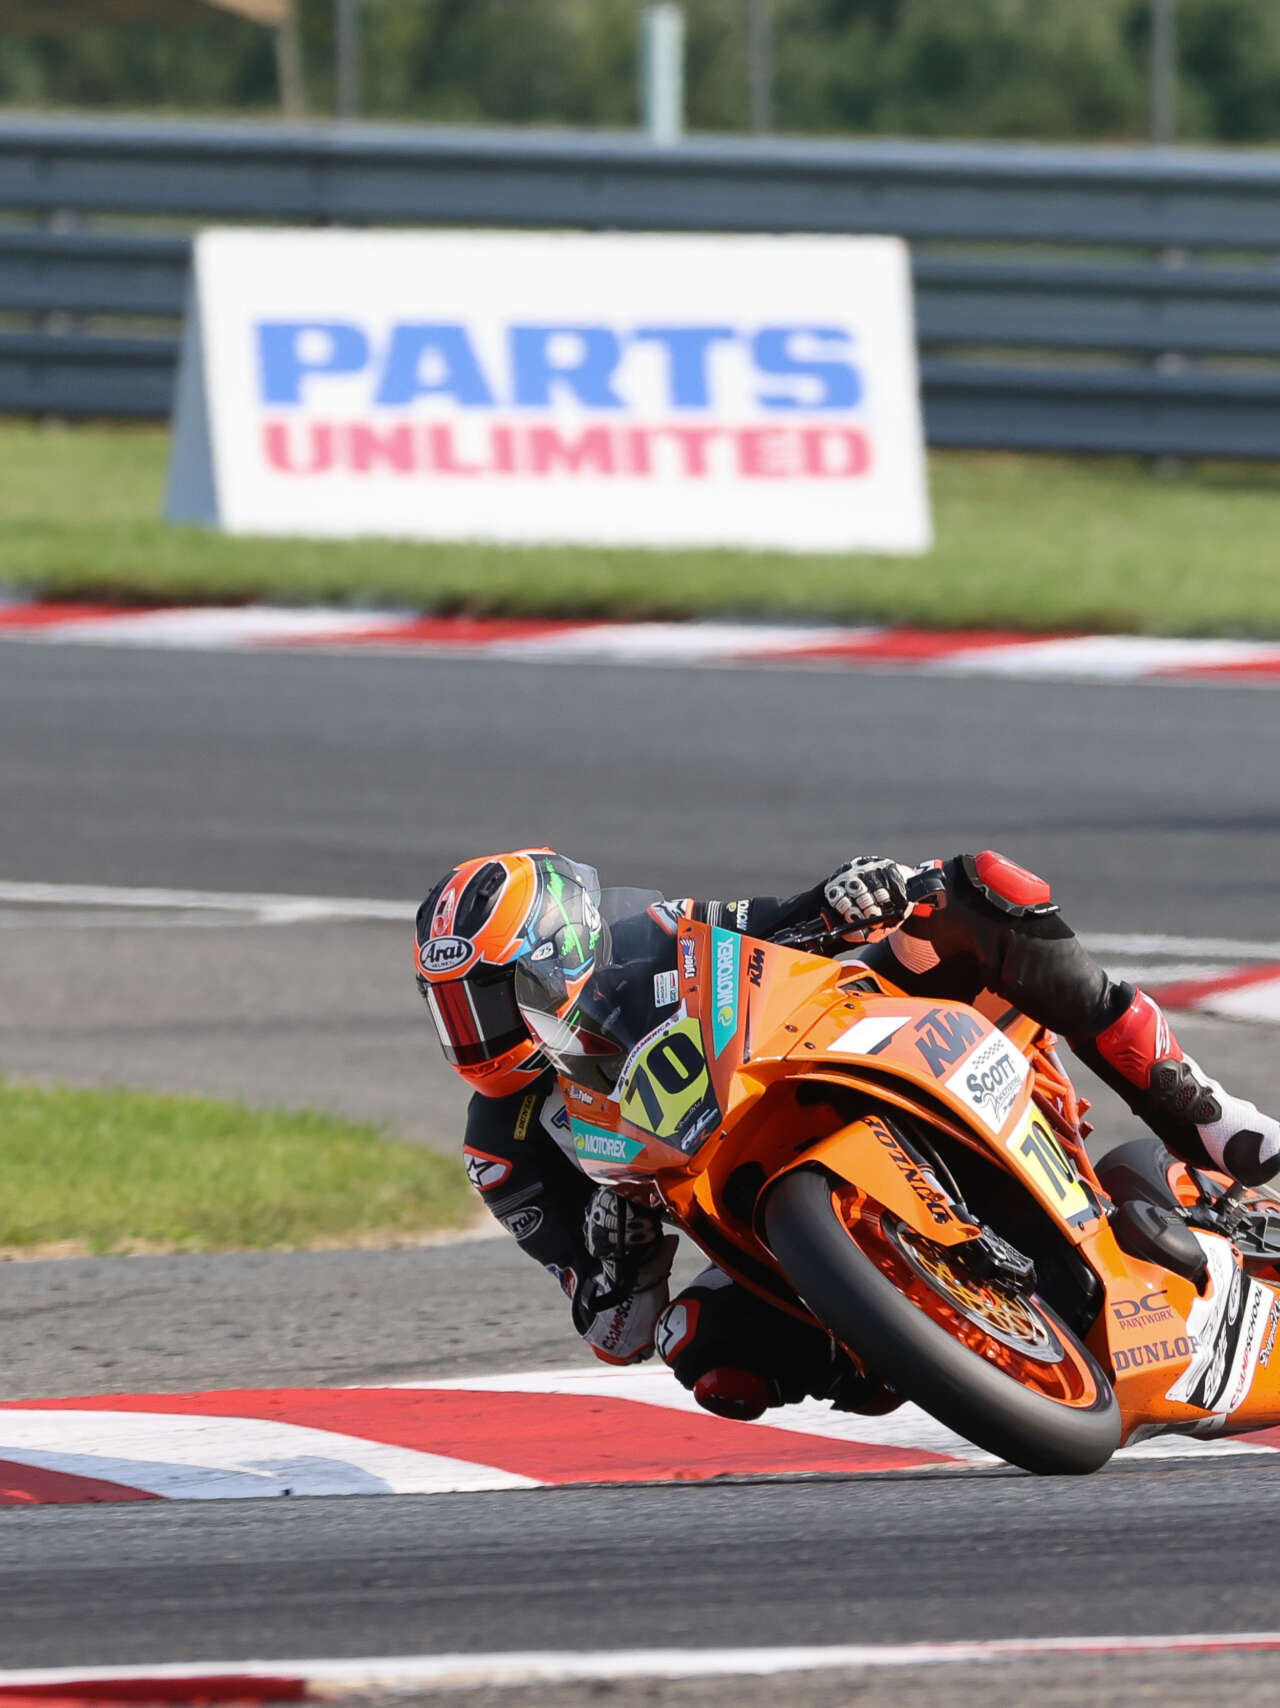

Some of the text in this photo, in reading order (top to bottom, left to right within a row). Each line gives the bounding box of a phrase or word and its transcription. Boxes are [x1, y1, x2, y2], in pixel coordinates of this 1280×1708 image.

[253, 321, 863, 411] PARTS
[262, 423, 873, 480] UNLIMITED
[422, 940, 466, 964] Arai
[716, 937, 735, 1008] MOTOREX
[747, 948, 766, 988] KTM
[914, 1008, 985, 1079] KTM
[624, 1031, 706, 1133] 70
[966, 1053, 1016, 1104] SCOTT
[584, 1134, 627, 1159] MOTOREX
[1020, 1120, 1075, 1201] 70
[1111, 1290, 1170, 1320] DC
[1112, 1335, 1201, 1372] DUNLOP
